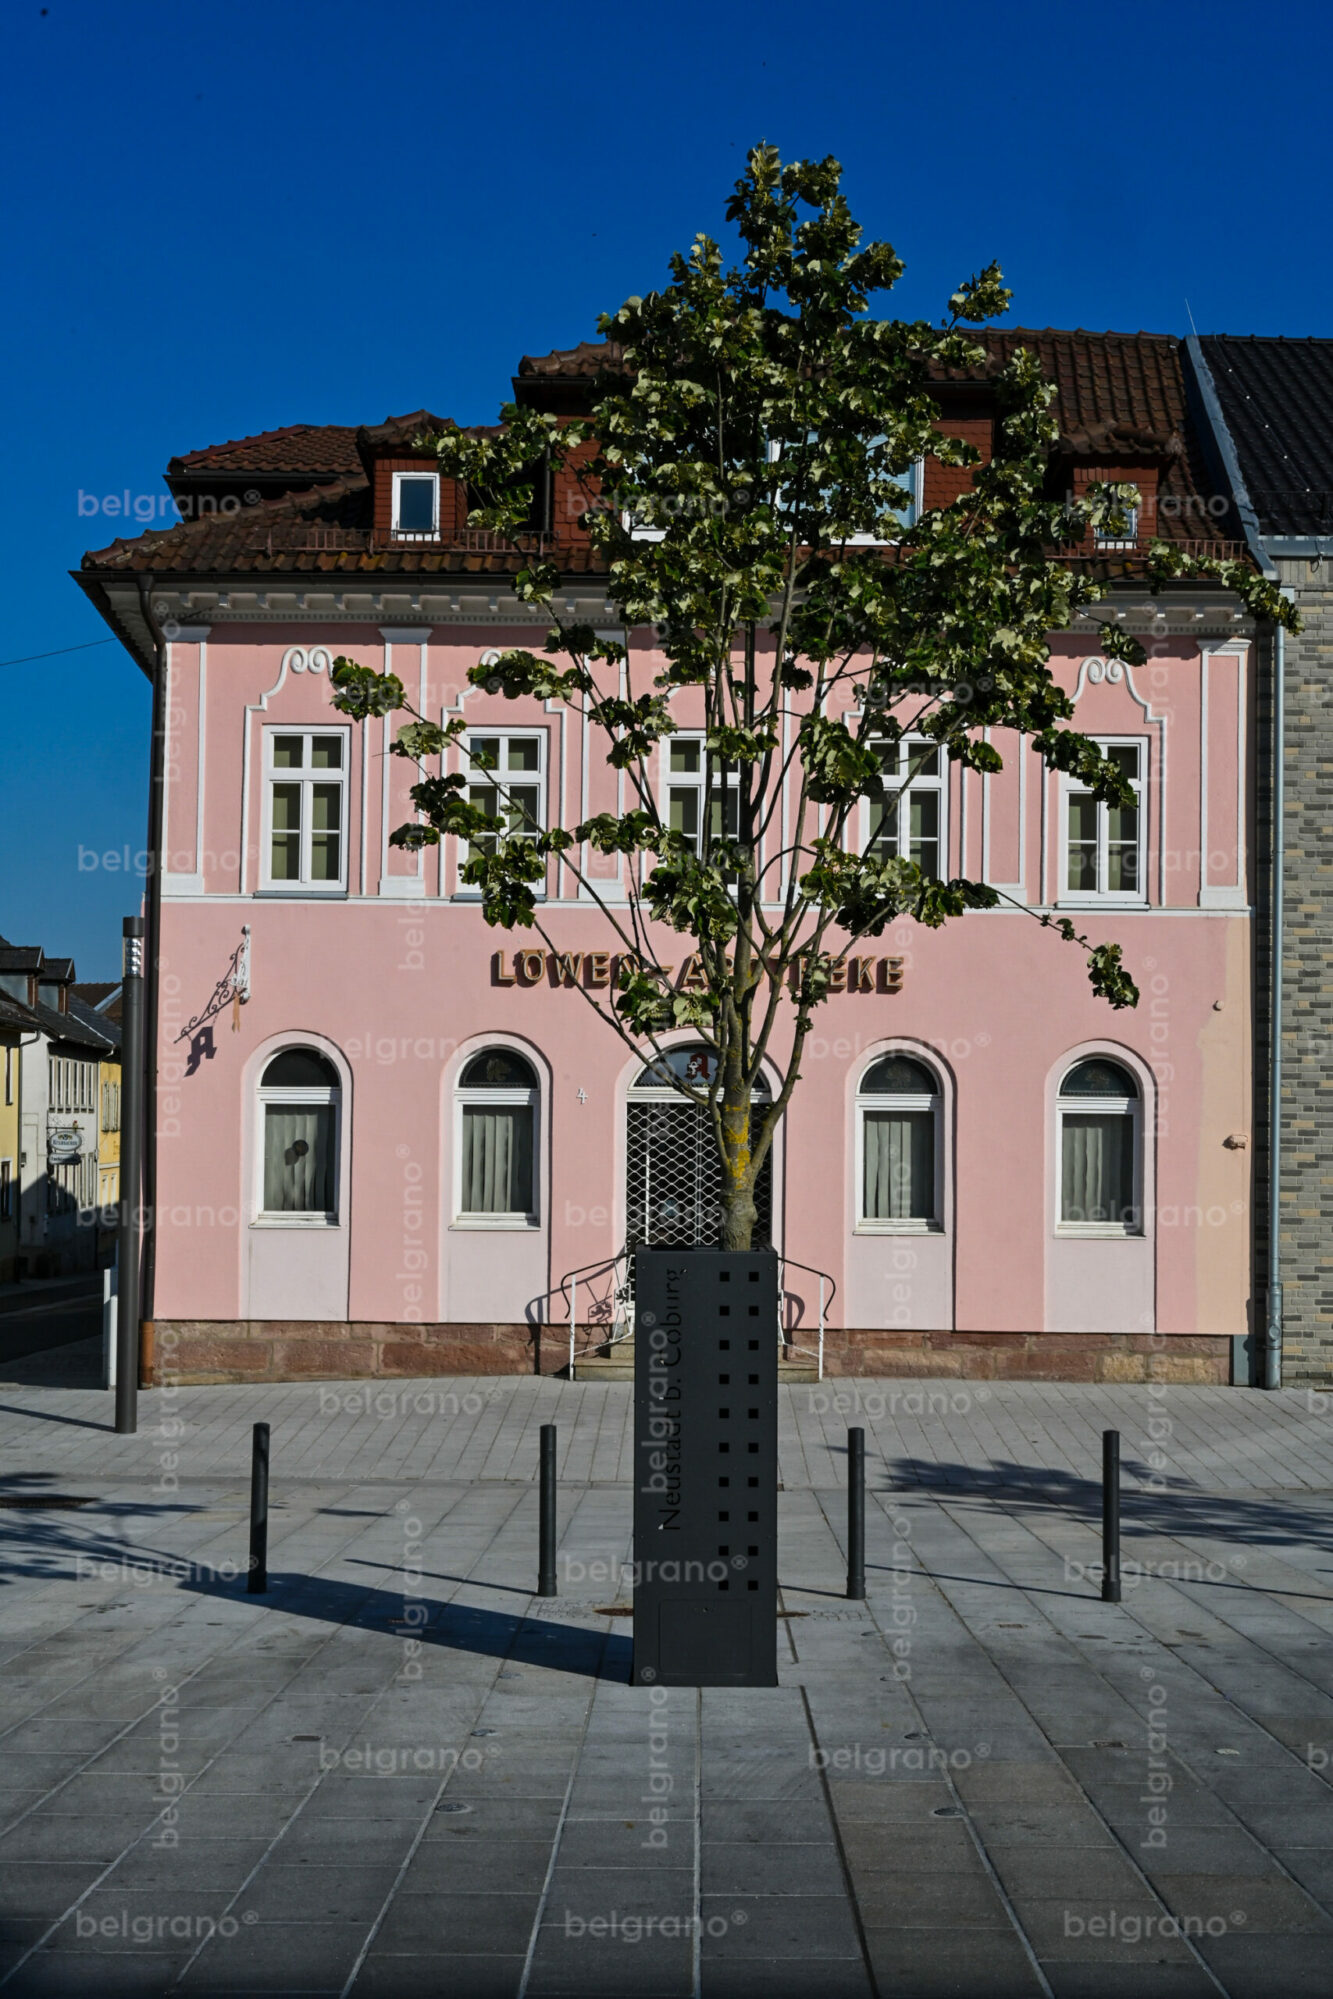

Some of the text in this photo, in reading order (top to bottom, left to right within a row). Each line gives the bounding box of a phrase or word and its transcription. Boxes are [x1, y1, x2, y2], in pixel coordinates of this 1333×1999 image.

[576, 1088, 588, 1104] 4
[658, 1268, 686, 1367] Coburg
[658, 1409, 681, 1530] Neustadt
